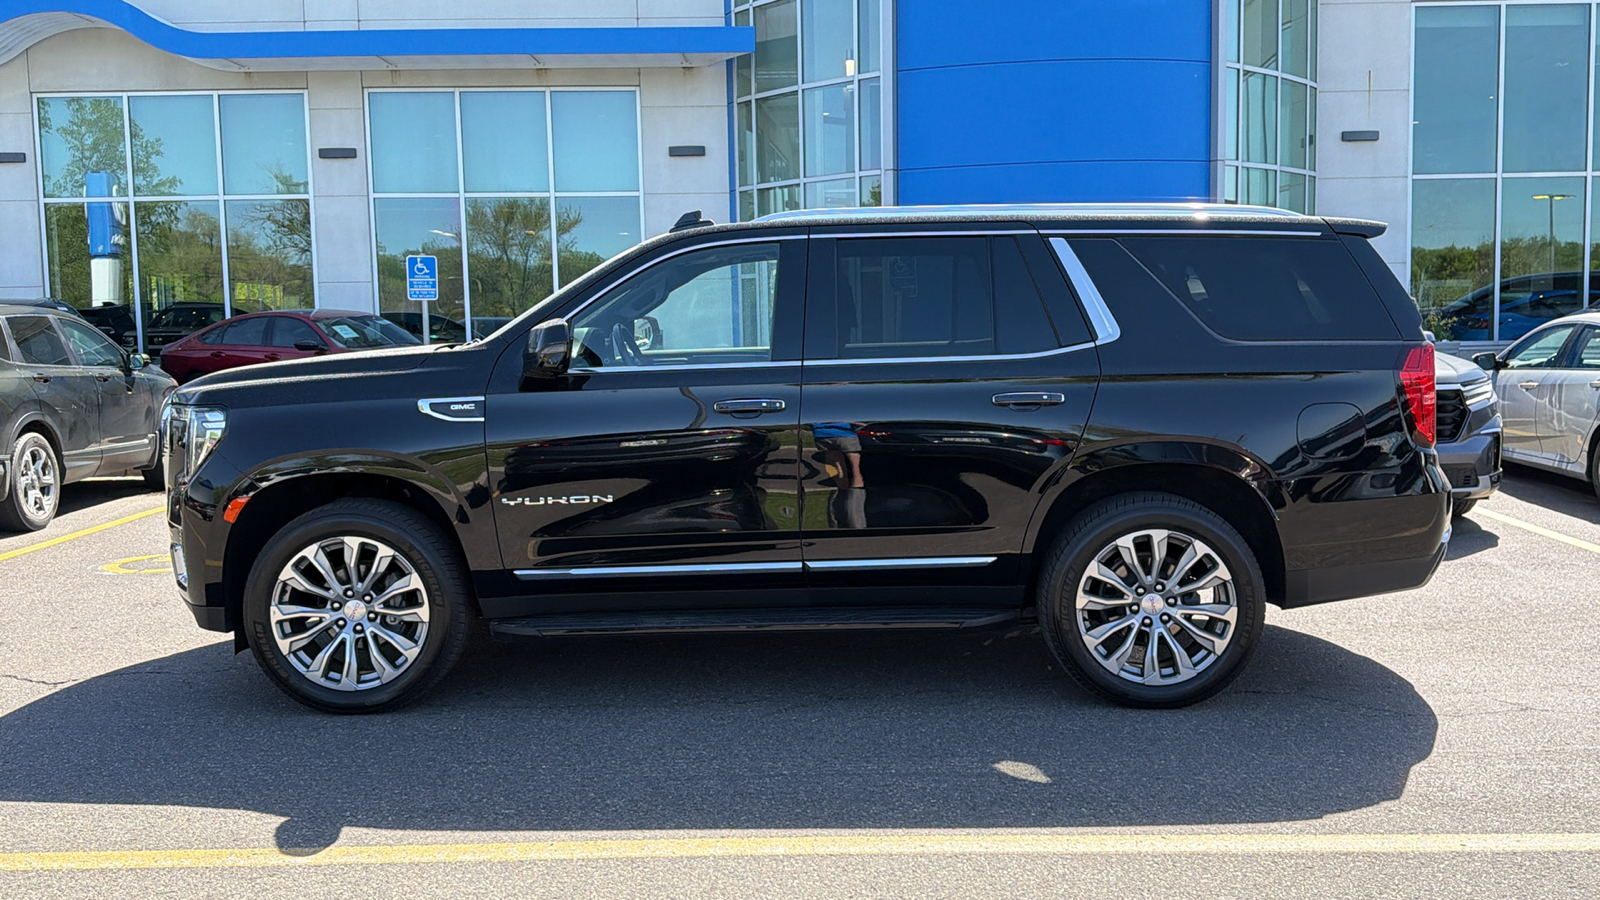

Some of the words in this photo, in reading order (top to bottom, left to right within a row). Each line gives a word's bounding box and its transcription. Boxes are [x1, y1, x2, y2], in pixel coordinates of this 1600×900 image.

[501, 494, 614, 506] YUKON
[349, 602, 361, 620] GMC
[1148, 595, 1158, 615] GMC
